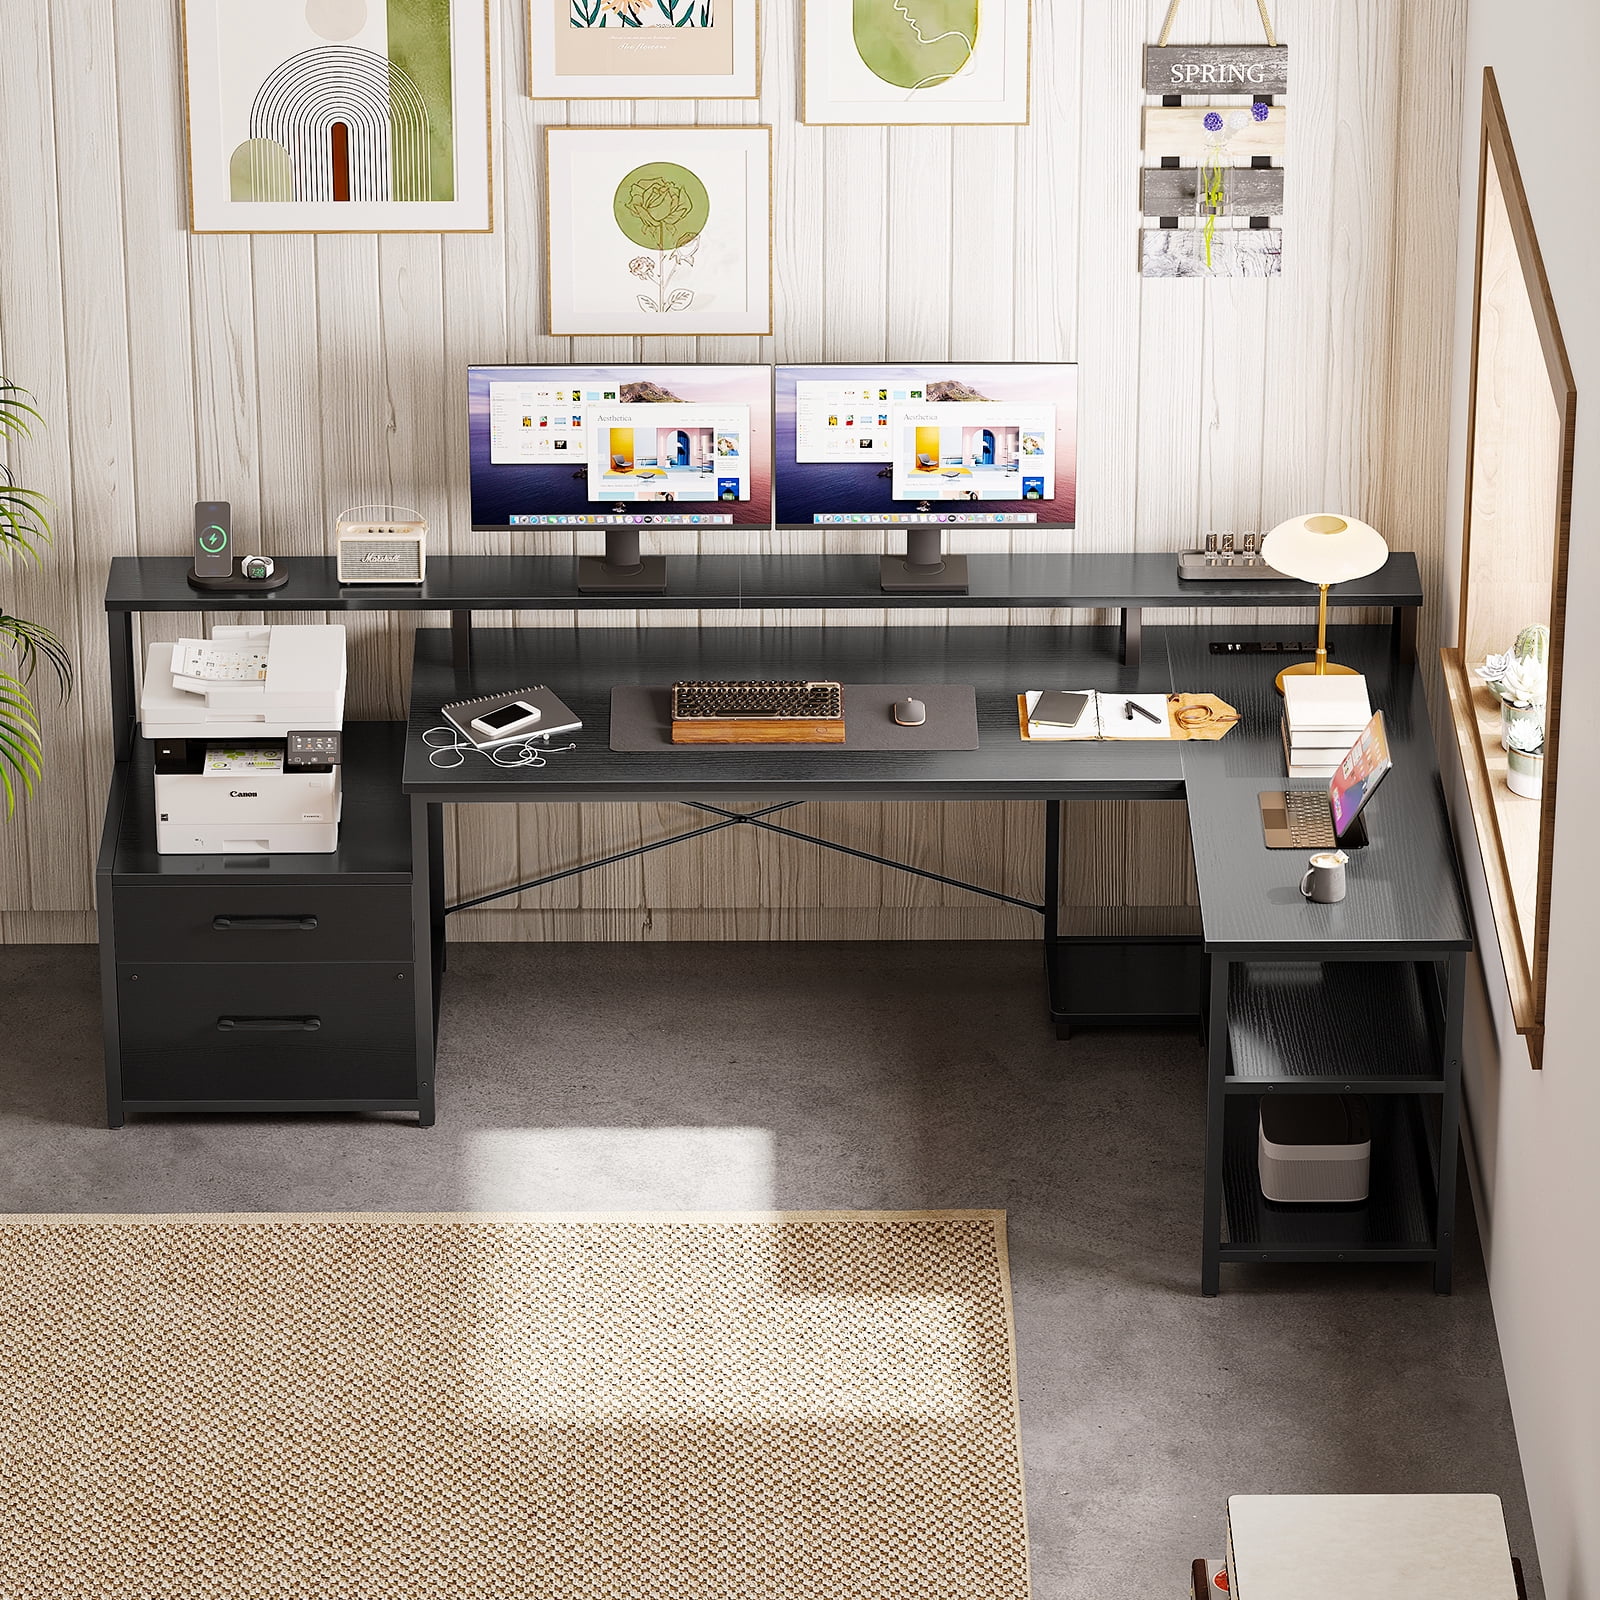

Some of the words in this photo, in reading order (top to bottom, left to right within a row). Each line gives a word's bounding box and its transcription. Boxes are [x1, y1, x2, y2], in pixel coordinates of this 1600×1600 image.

[1170, 64, 1265, 83] SPRING
[360, 552, 401, 563] Marshall
[229, 790, 258, 798] Canon
